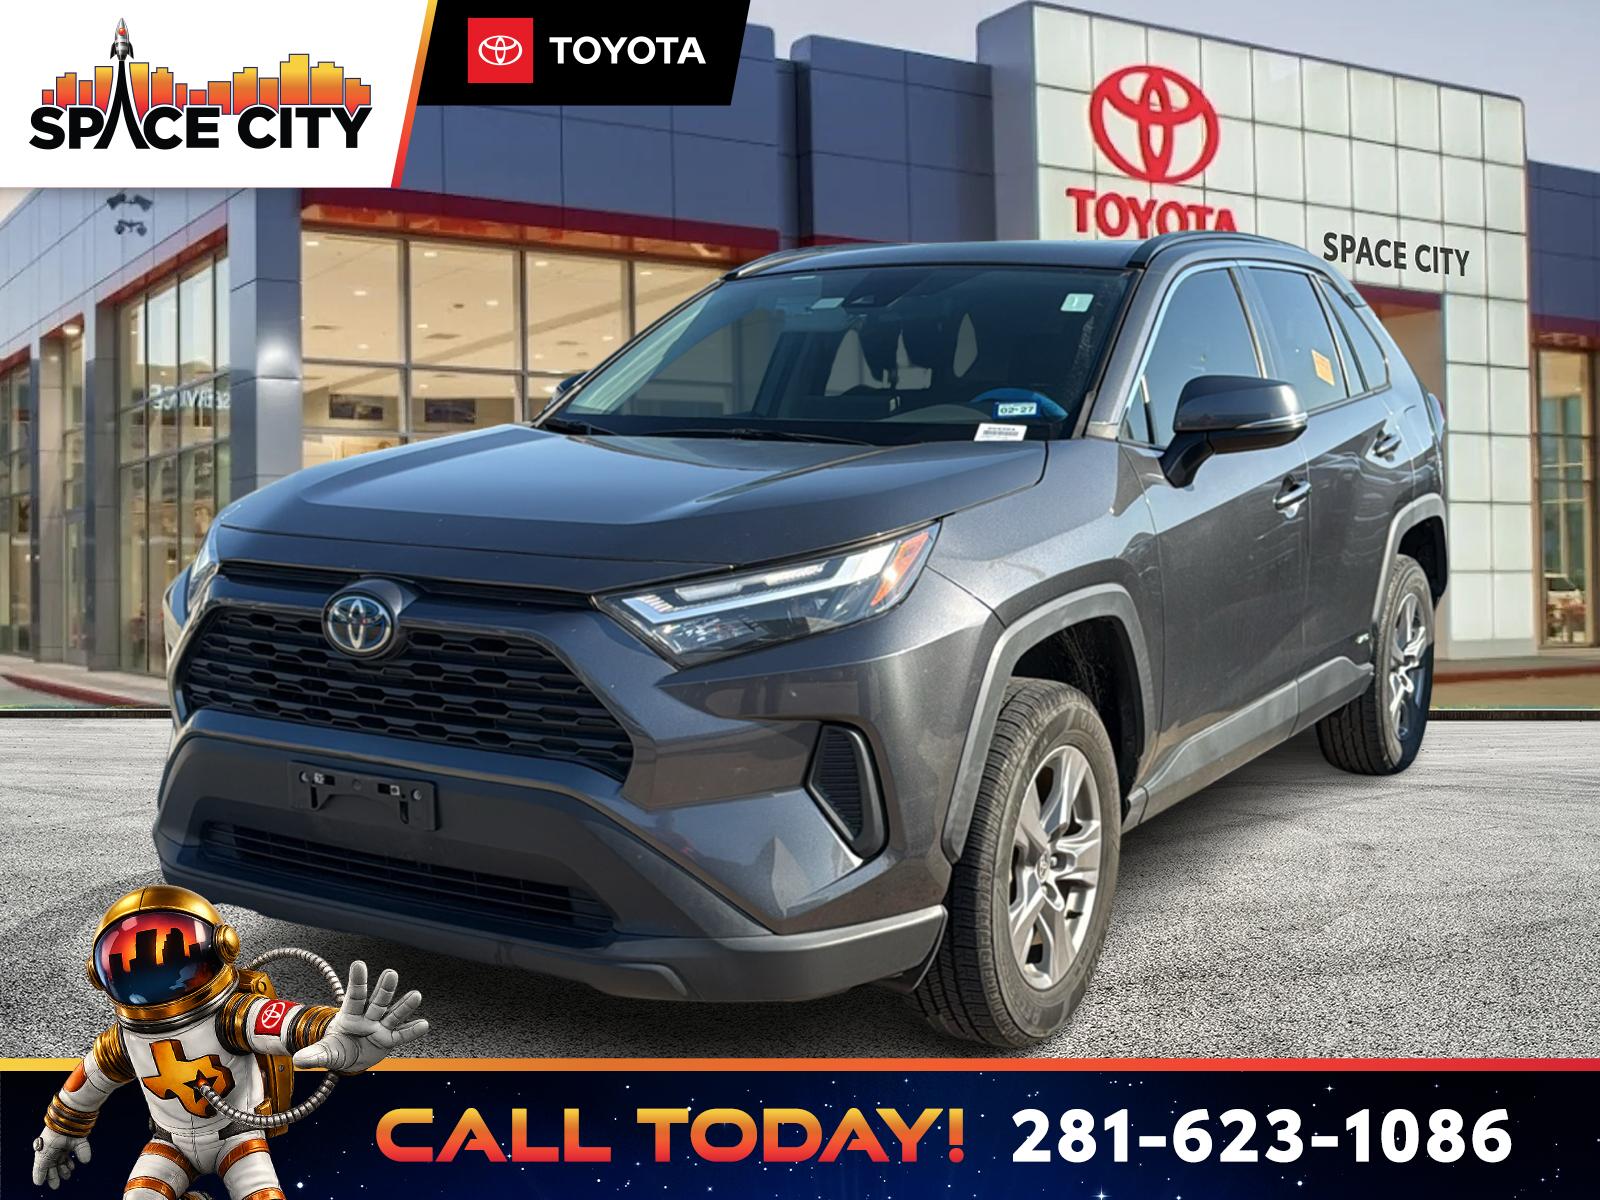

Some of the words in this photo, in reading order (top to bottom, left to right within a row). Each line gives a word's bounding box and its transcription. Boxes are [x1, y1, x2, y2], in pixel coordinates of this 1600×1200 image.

[1066, 188, 1237, 239] TOYOTA
[1323, 232, 1407, 270] SPACE
[1414, 244, 1470, 277] CITY
